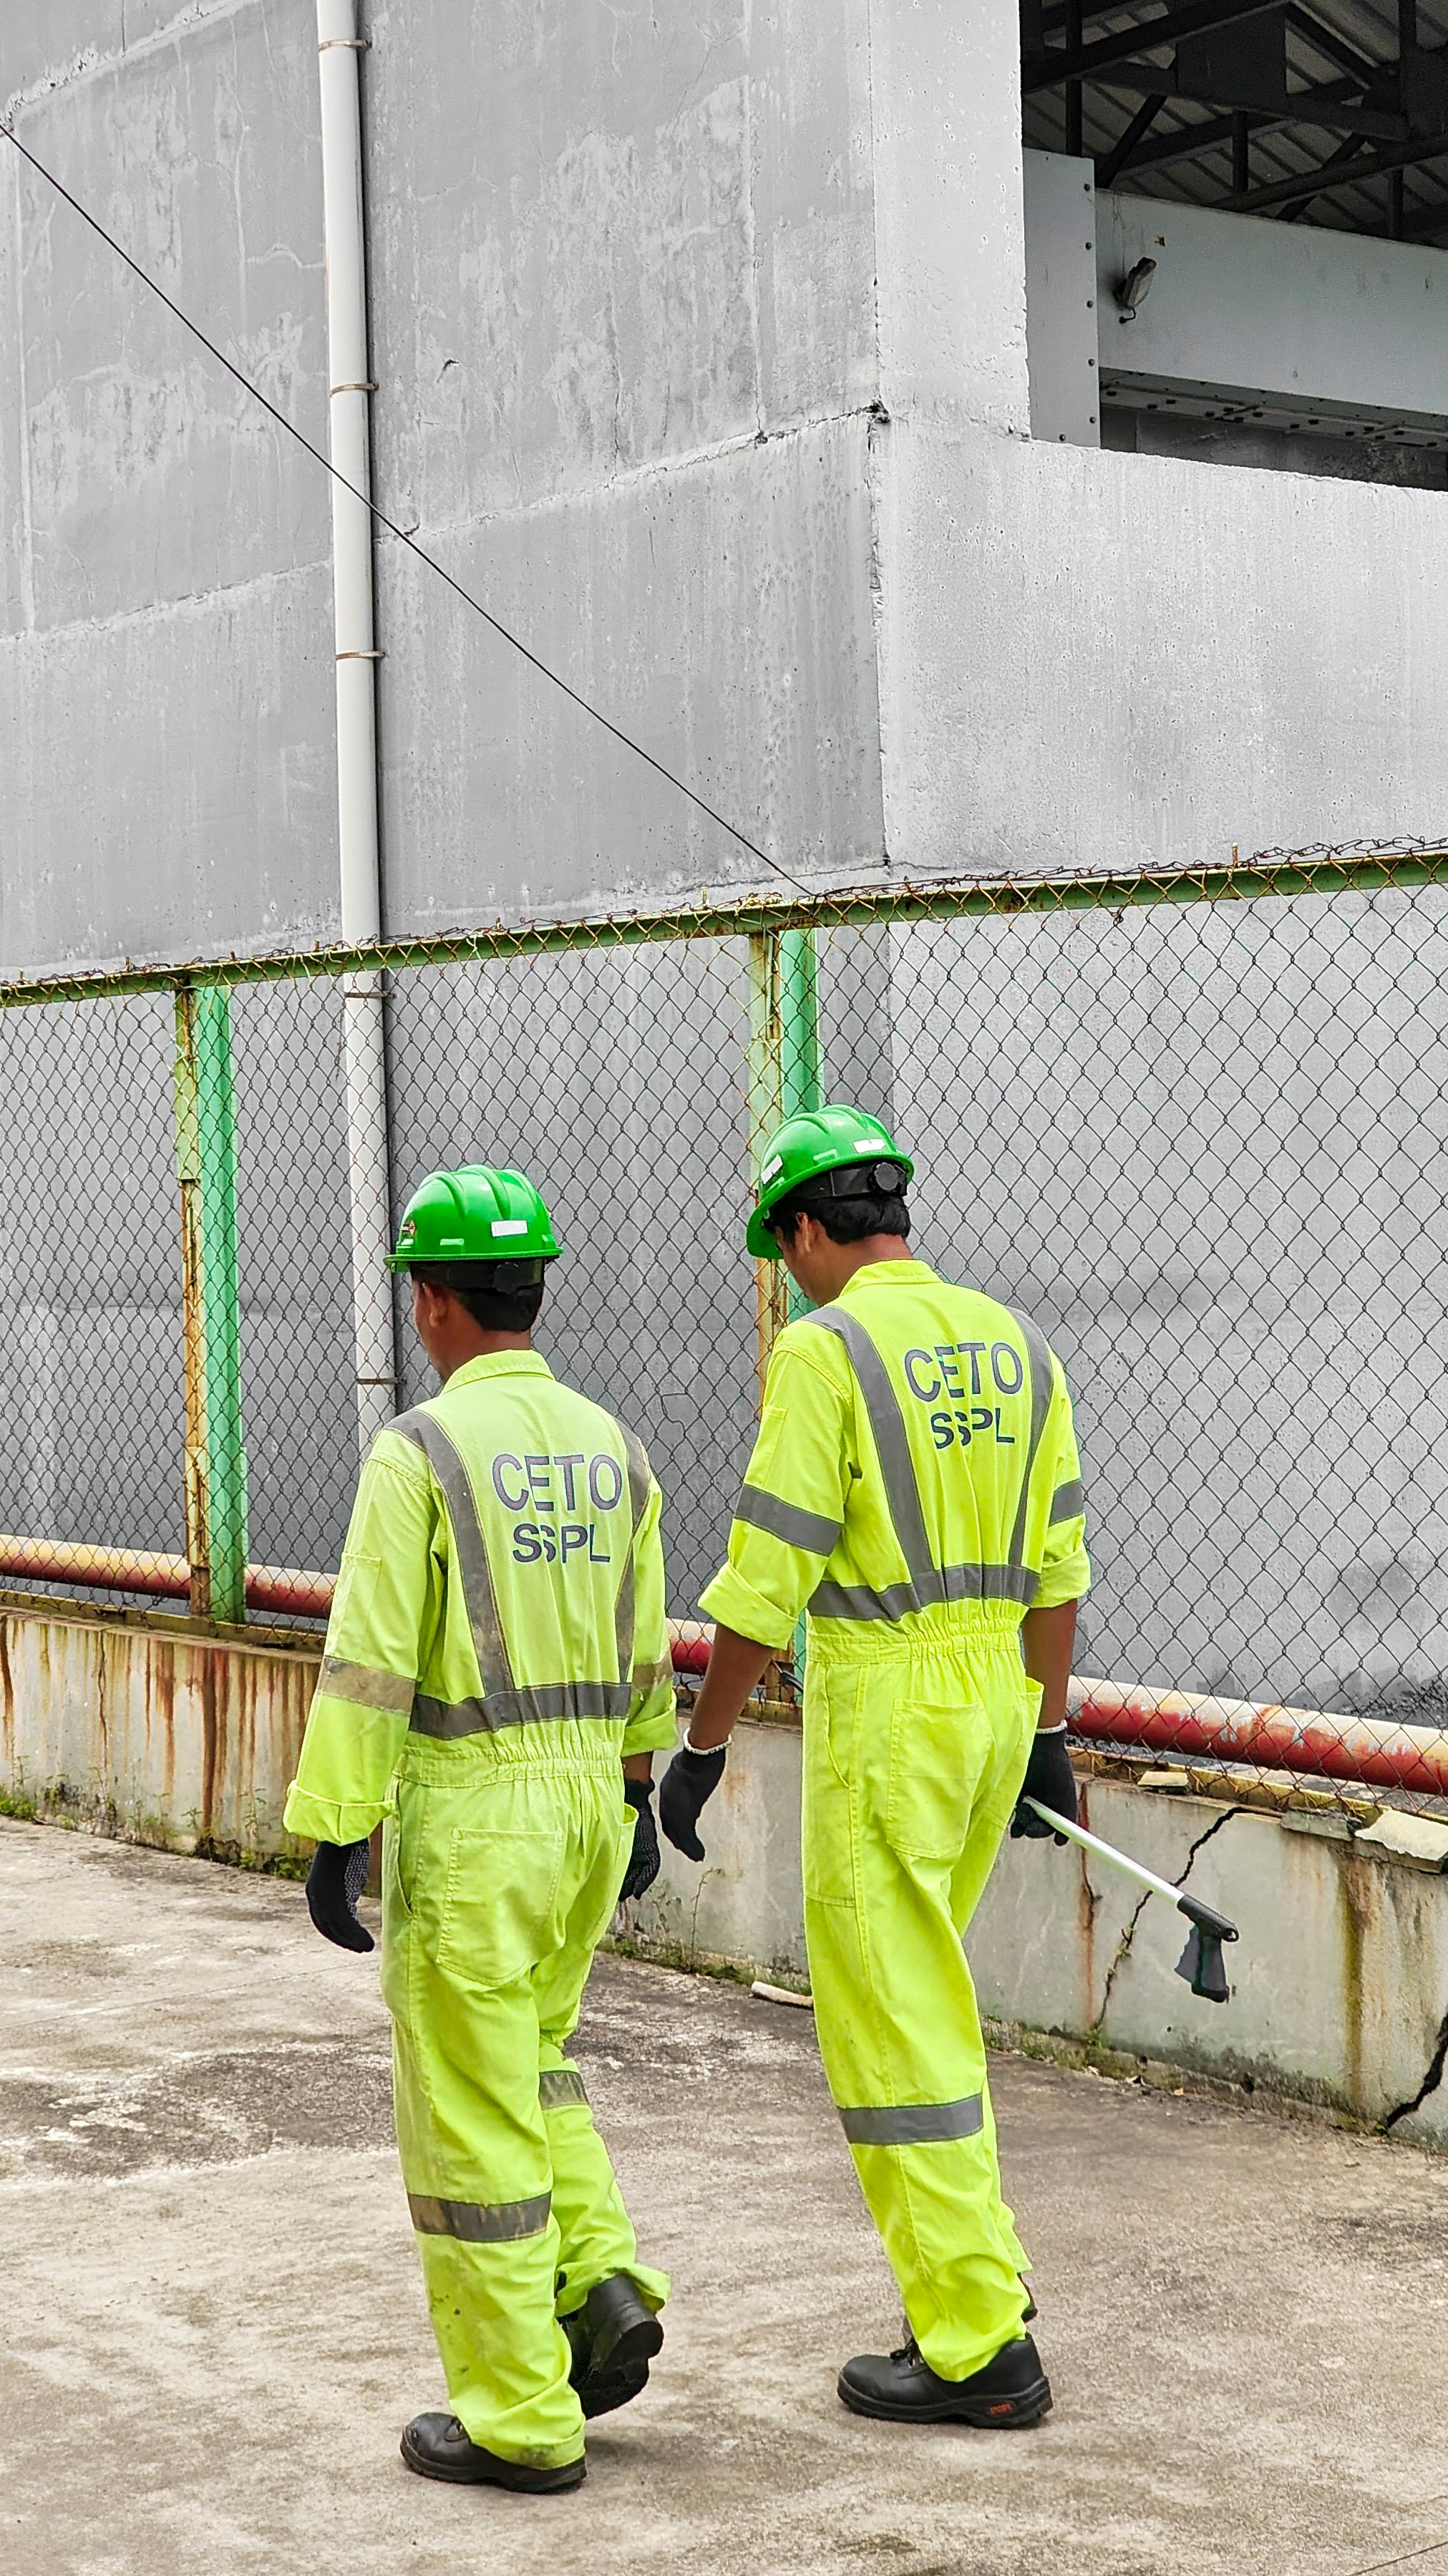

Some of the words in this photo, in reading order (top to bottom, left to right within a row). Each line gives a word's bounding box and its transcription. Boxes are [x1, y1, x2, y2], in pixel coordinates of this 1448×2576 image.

[904, 1342, 1024, 1403] CETO
[930, 1407, 1015, 1450] SSPL
[492, 1453, 622, 1511] CETO
[512, 1523, 611, 1564] SSPL
